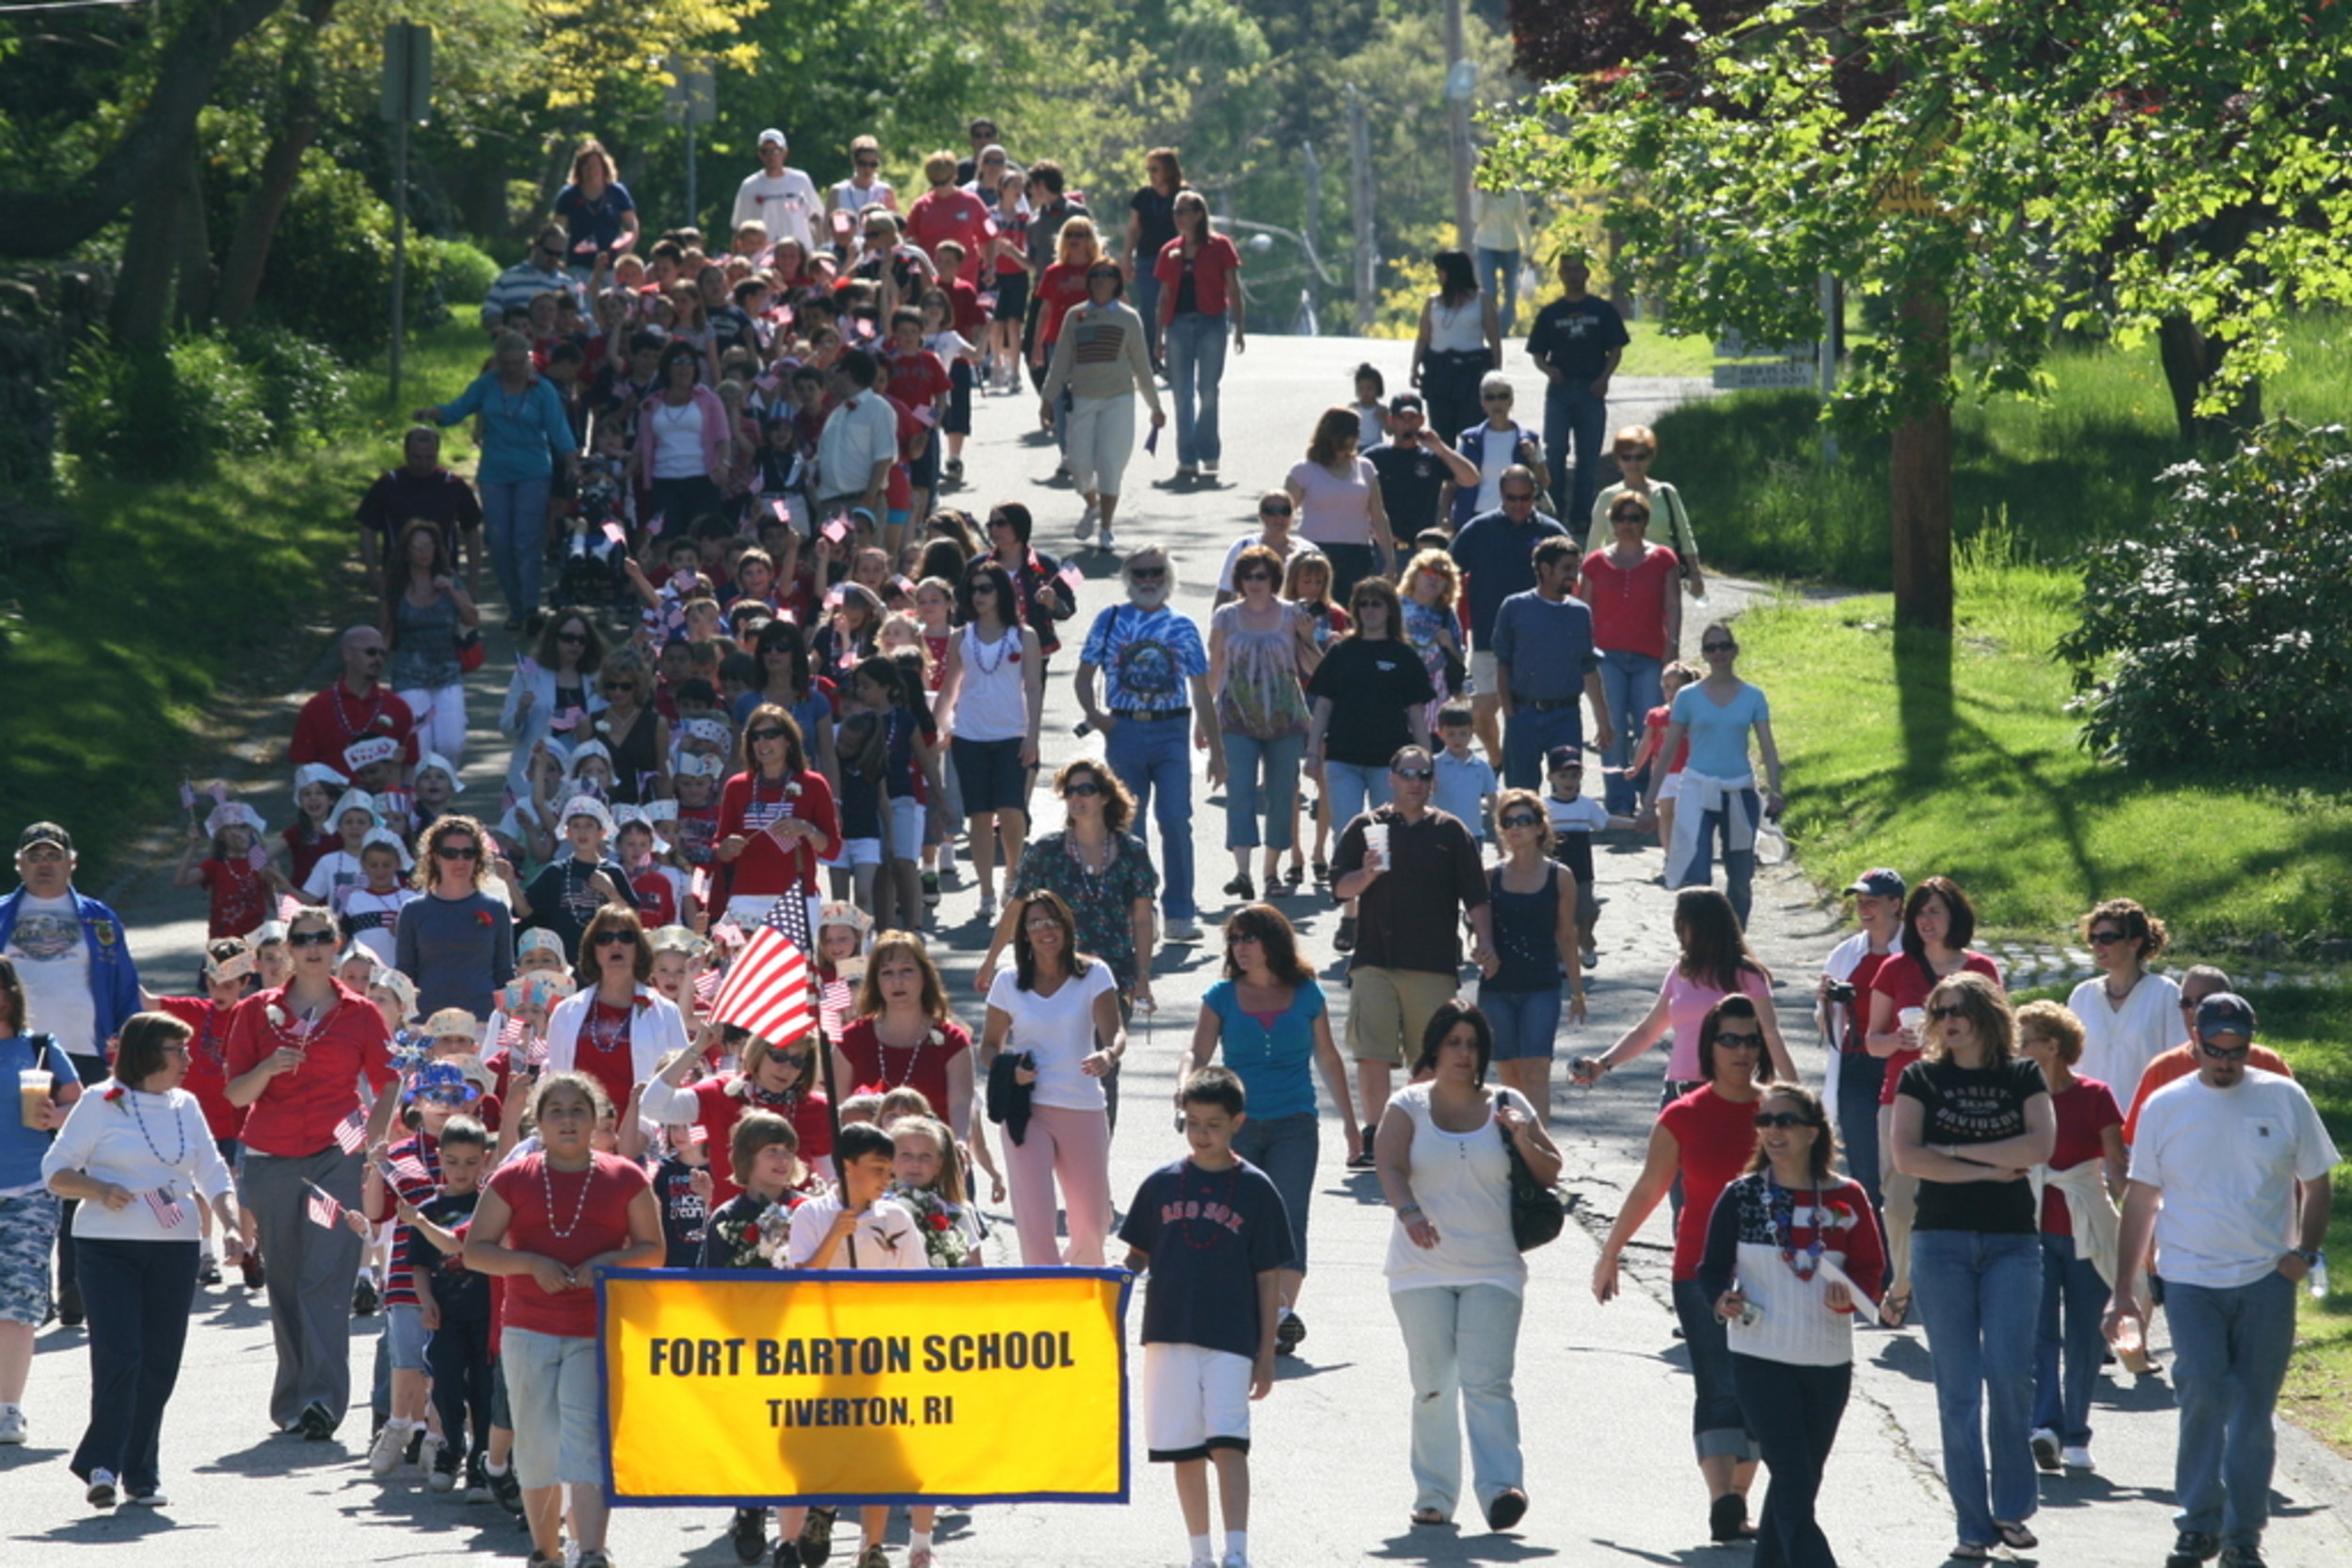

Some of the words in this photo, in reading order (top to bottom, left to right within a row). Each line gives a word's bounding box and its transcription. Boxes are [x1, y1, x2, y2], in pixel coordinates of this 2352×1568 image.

[1161, 1200, 1200, 1224] RED
[1202, 1201, 1245, 1235] SOX
[650, 1338, 745, 1376] FORT
[755, 1336, 911, 1375] BARTON
[923, 1331, 1074, 1371] SCHOOL
[767, 1397, 915, 1428] TIVERTON,
[924, 1396, 953, 1424] RI
